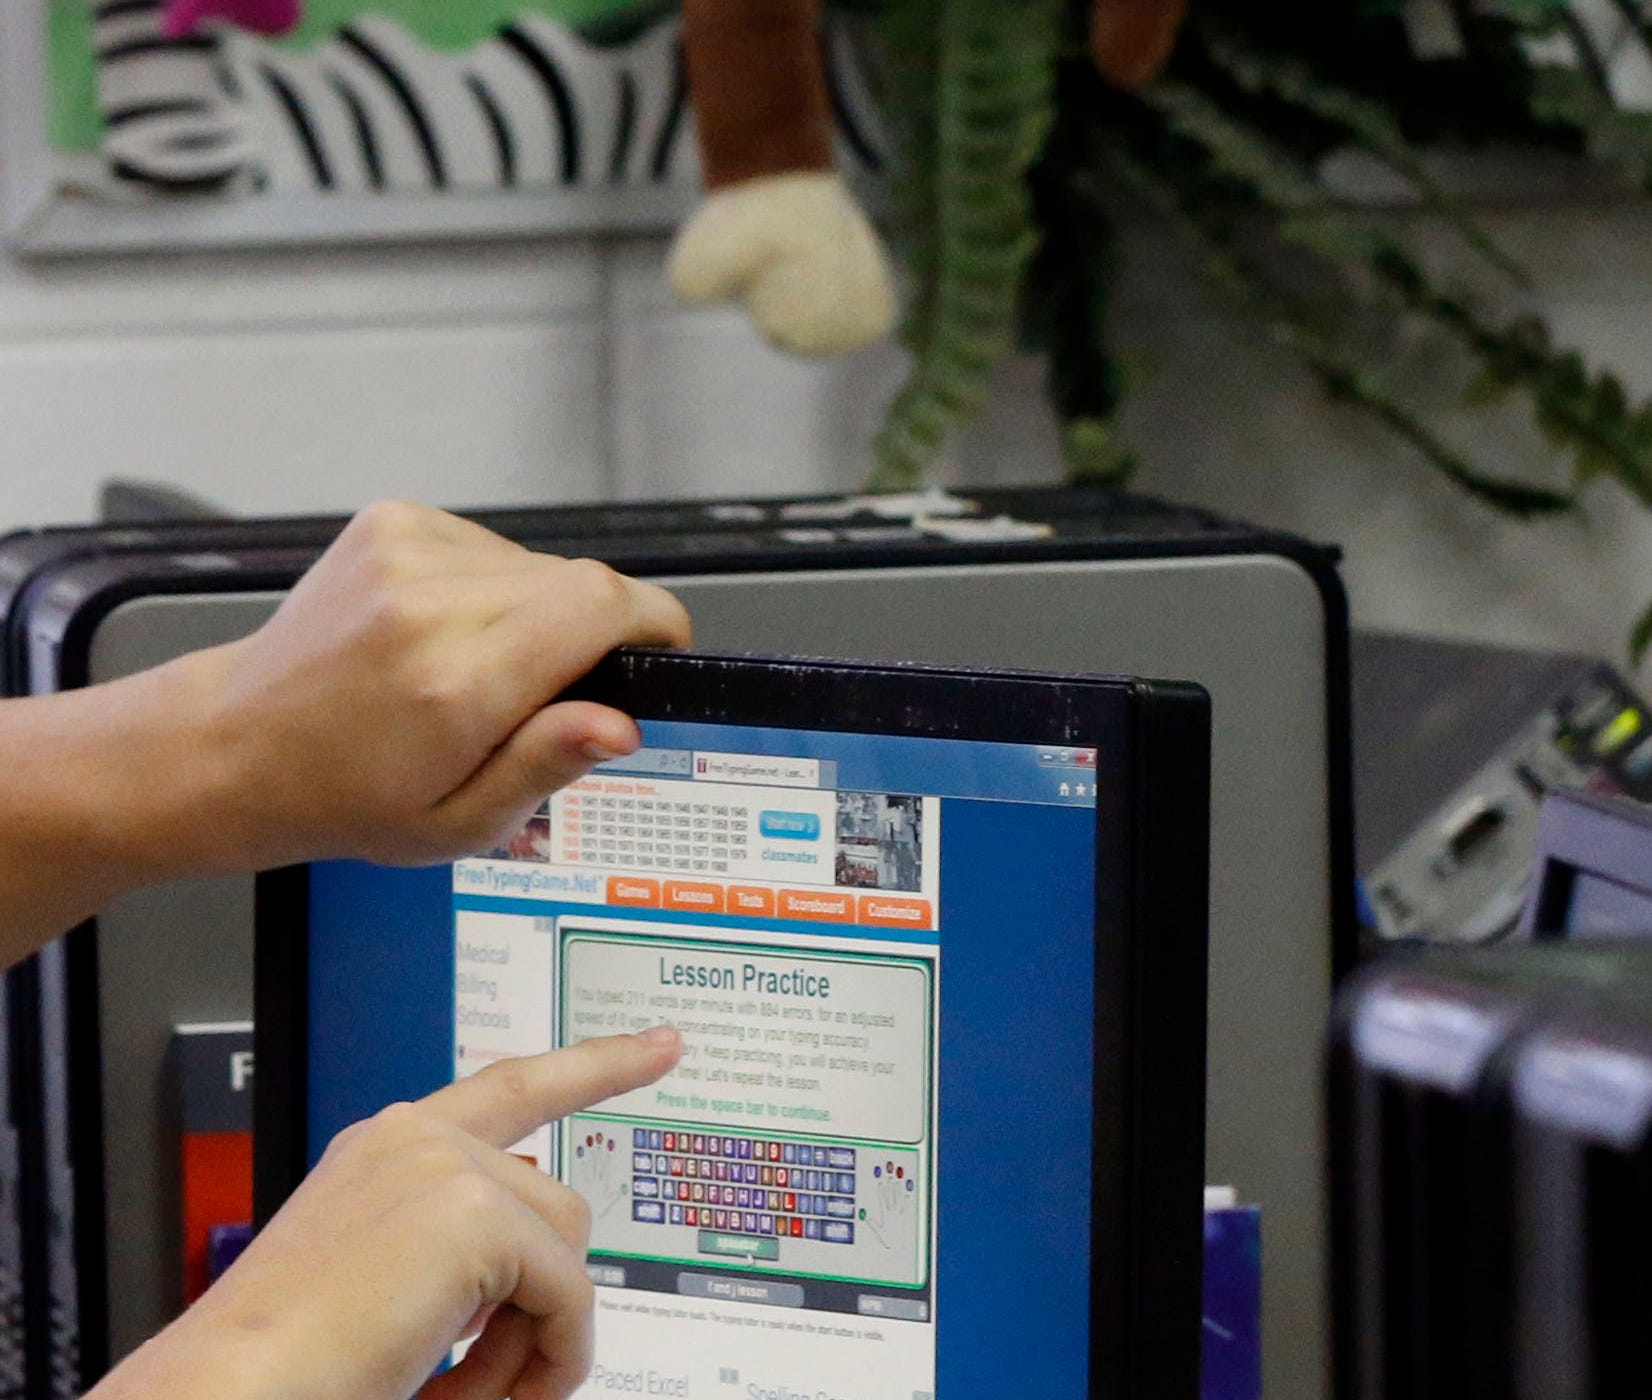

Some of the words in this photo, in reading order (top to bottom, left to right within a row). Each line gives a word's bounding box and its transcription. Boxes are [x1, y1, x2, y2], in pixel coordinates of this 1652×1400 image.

[761, 848, 817, 863] classmates
[616, 883, 649, 898] Games
[672, 888, 714, 903] Lessons
[737, 893, 764, 907] Tests
[787, 896, 844, 914] Scoreboard
[867, 903, 920, 919] Customize
[458, 940, 509, 965] Medical
[457, 973, 496, 1000] Billing
[659, 956, 734, 989] Lesson
[743, 963, 829, 998] Practice
[457, 1005, 510, 1029] Schools
[596, 988, 623, 1006] typed
[649, 993, 677, 1008] words
[681, 995, 697, 1012] per
[701, 997, 732, 1013] minute
[736, 1000, 756, 1015] with
[819, 1007, 831, 1022] for
[835, 1009, 848, 1023] an
[851, 1010, 894, 1029] adjusted
[574, 1009, 603, 1027] speed
[606, 1012, 615, 1026] of
[677, 1018, 744, 1040] concentrating
[749, 1024, 760, 1039] on
[764, 1026, 786, 1044] your
[789, 1028, 819, 1047] typing
[704, 1045, 729, 1062] Keep
[788, 1052, 806, 1069] you
[811, 1054, 825, 1069] will
[829, 1056, 868, 1072] achieve
[872, 1060, 894, 1077] your
[732, 1071, 762, 1088] repeat
[767, 1074, 782, 1087] the
[657, 1092, 685, 1108] Press
[690, 1095, 707, 1110] the
[711, 1097, 742, 1115] space
[746, 1100, 764, 1115] bar
[767, 1102, 777, 1116] to
[712, 1282, 730, 1294] and
[737, 1284, 767, 1298] lesson
[648, 1370, 688, 1398] Excel
